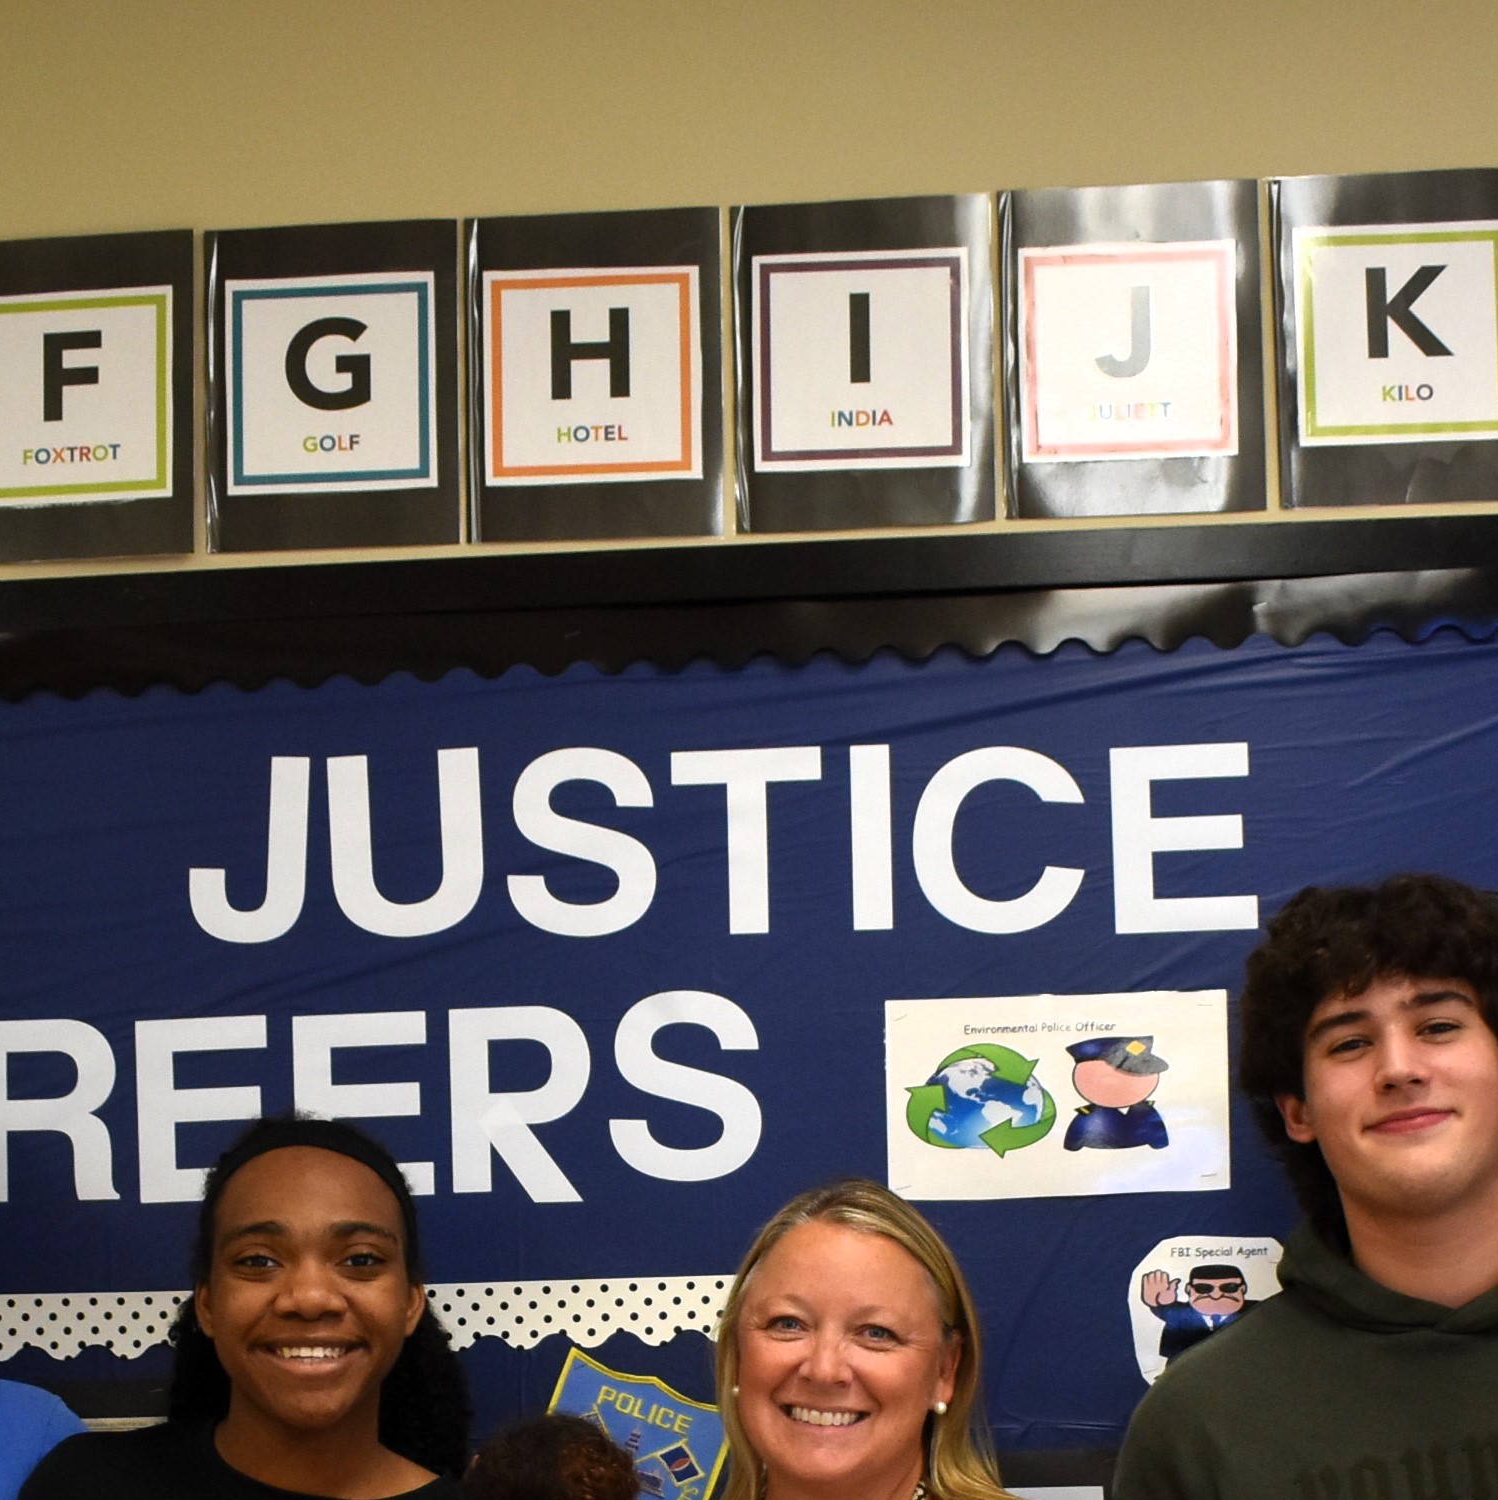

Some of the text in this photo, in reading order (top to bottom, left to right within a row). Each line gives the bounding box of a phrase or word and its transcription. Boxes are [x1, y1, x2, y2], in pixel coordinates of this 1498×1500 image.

[1365, 264, 1454, 359] K
[848, 292, 871, 384] I
[1094, 285, 1151, 378] J
[284, 316, 372, 411] G
[550, 307, 631, 400] H
[42, 329, 102, 422] F
[1381, 384, 1434, 402] KILO
[830, 409, 894, 428] INDIA
[1088, 402, 1172, 421] JULIETT
[302, 433, 361, 453] GOLF
[557, 424, 628, 444] HOTEL
[22, 443, 121, 466] FOXTROT
[188, 741, 1259, 945] JUSTICE
[964, 1021, 1116, 1035] Environmental Police Officer
[1171, 1247, 1268, 1260] FBI Special Agent
[597, 1386, 693, 1435] POLICE
